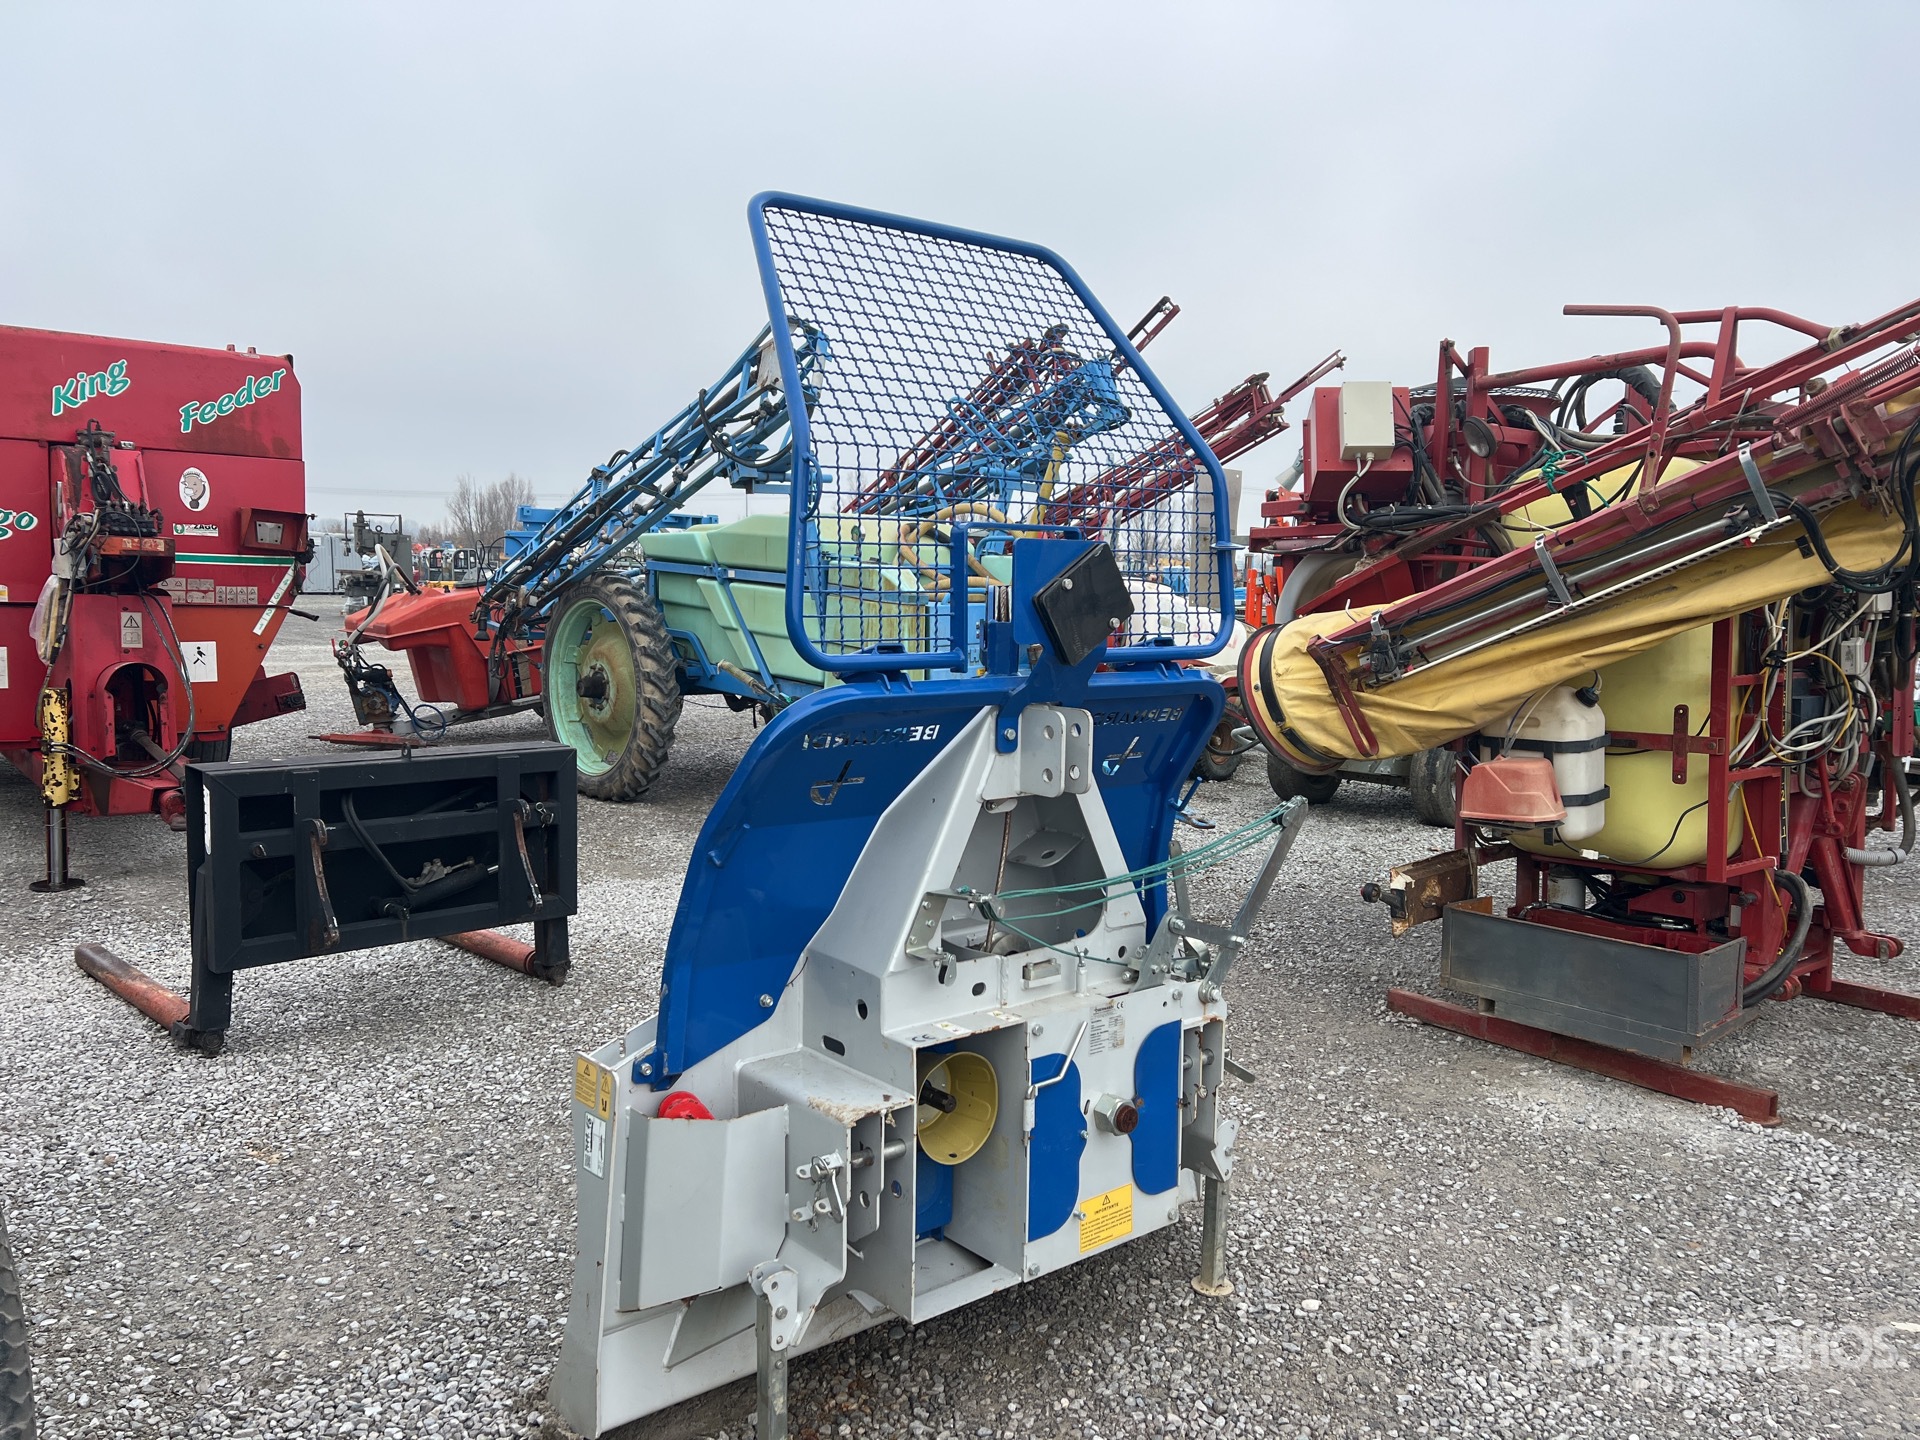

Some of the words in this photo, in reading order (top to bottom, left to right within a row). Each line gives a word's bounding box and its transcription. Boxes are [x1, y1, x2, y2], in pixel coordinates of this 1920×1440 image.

[52, 359, 131, 416] King
[179, 368, 286, 433] Feeder
[1094, 1202, 1119, 1215] IMPORTANTE
